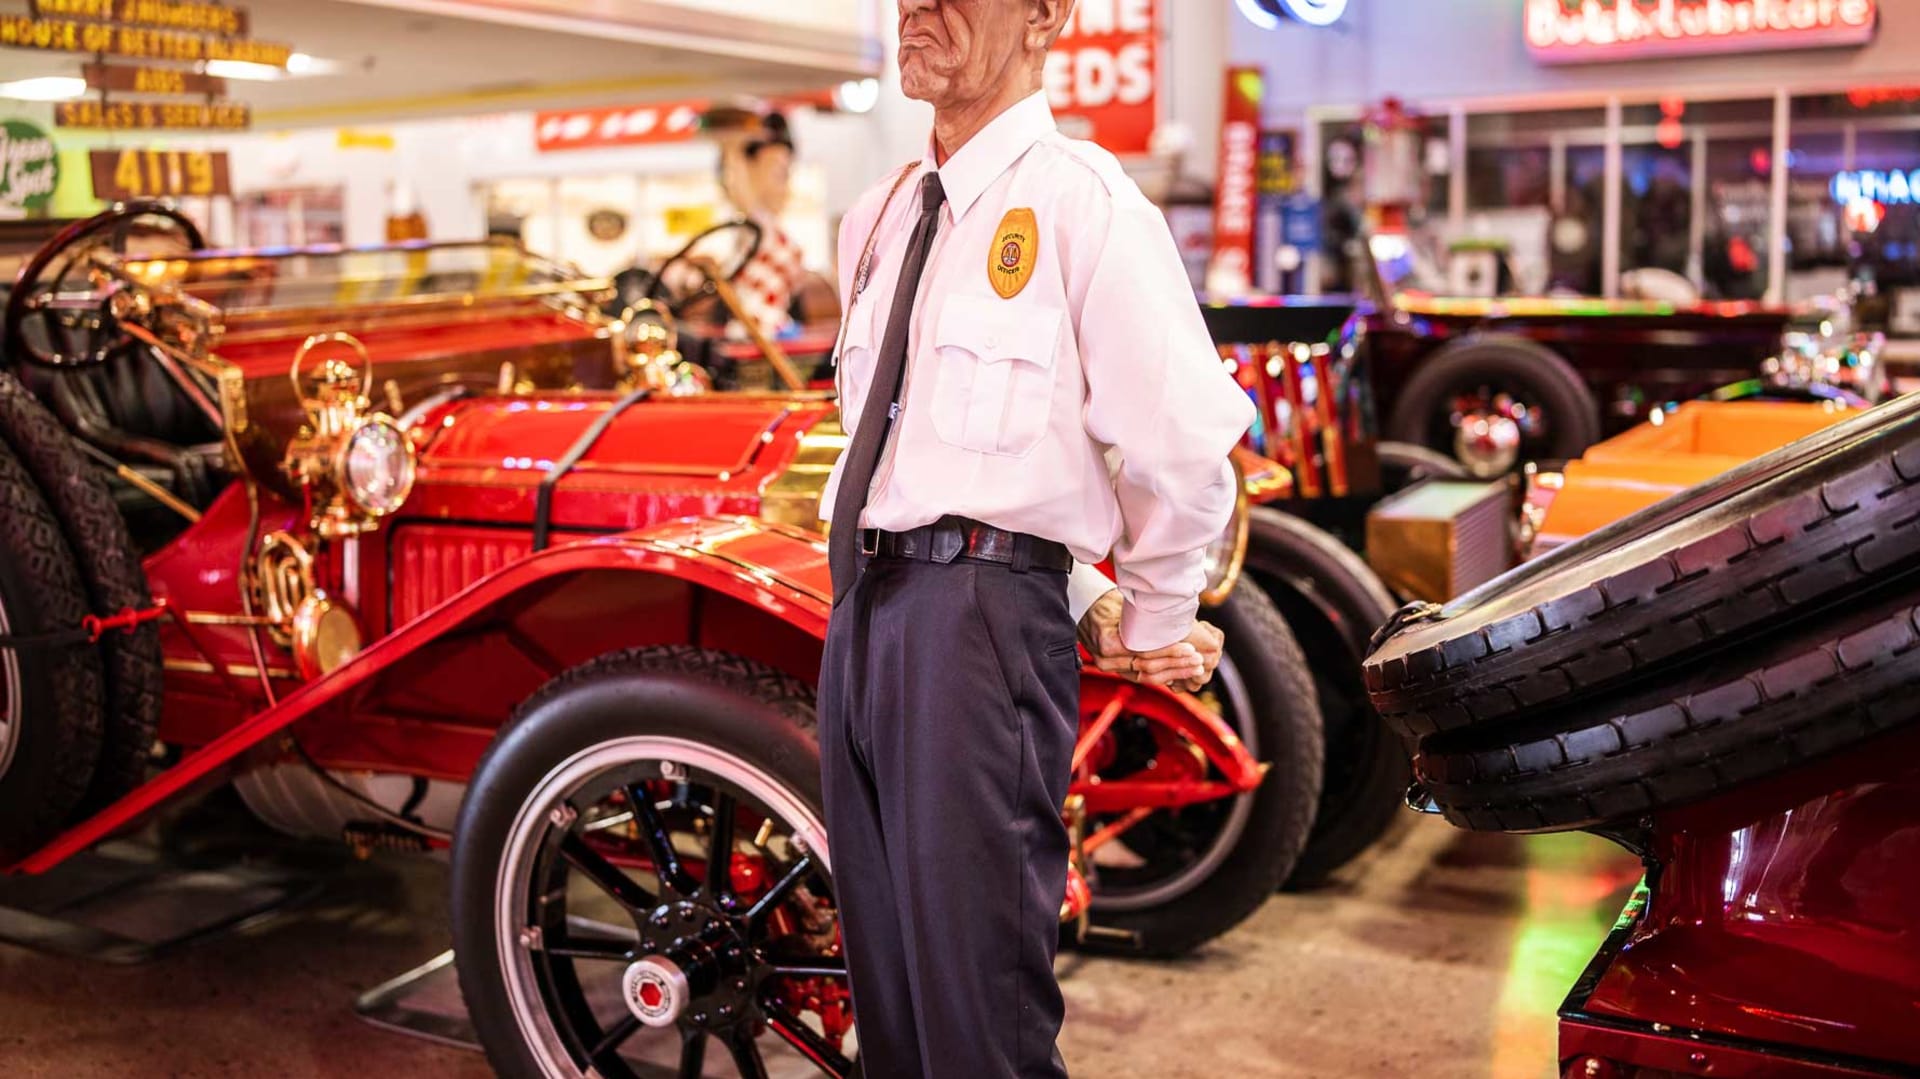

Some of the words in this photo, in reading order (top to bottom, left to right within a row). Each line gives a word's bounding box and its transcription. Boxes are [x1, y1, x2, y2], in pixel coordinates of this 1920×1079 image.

[0, 17, 76, 52] HOUSE
[82, 23, 112, 52] OF
[119, 27, 200, 60] BETTER
[63, 102, 135, 128] SALES
[162, 103, 246, 130] SERVICE
[114, 148, 213, 197] 4119
[1002, 232, 1026, 243] SECURITY
[997, 264, 1020, 275] OFFICER
